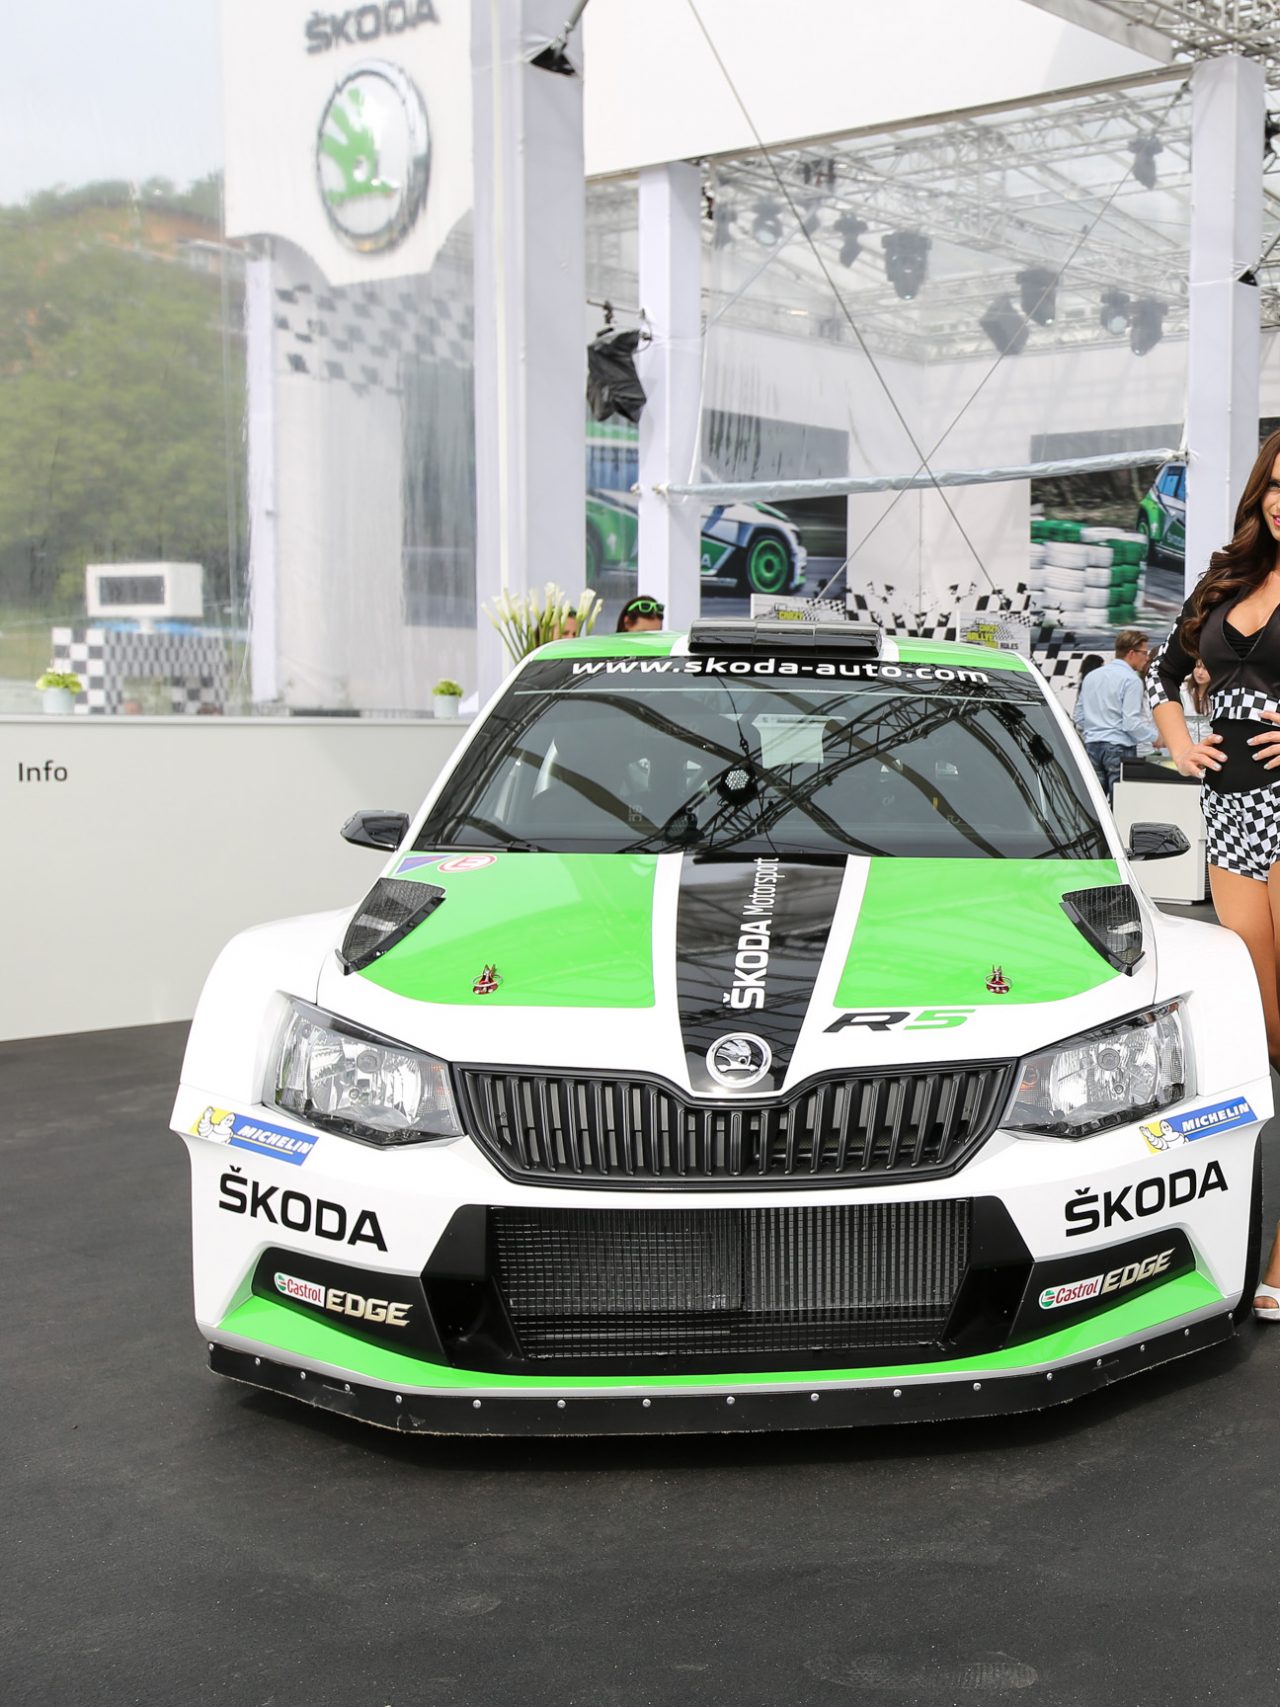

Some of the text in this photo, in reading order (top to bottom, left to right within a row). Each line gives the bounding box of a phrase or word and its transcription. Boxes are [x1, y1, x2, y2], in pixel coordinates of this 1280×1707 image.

[572, 657, 990, 684] www.skoda-auto.com
[18, 759, 68, 782] Info
[722, 857, 785, 1009] ŠKODA Motorsport
[822, 1009, 976, 1033] R5
[1181, 1102, 1250, 1132] MICHELIN
[236, 1124, 314, 1155] MICHELIN
[218, 1164, 388, 1252] ŠKODA
[1064, 1160, 1229, 1237] ŠKODA
[1055, 1247, 1177, 1305] Castrol EDGE
[286, 1278, 414, 1328] Castrol EDGE
